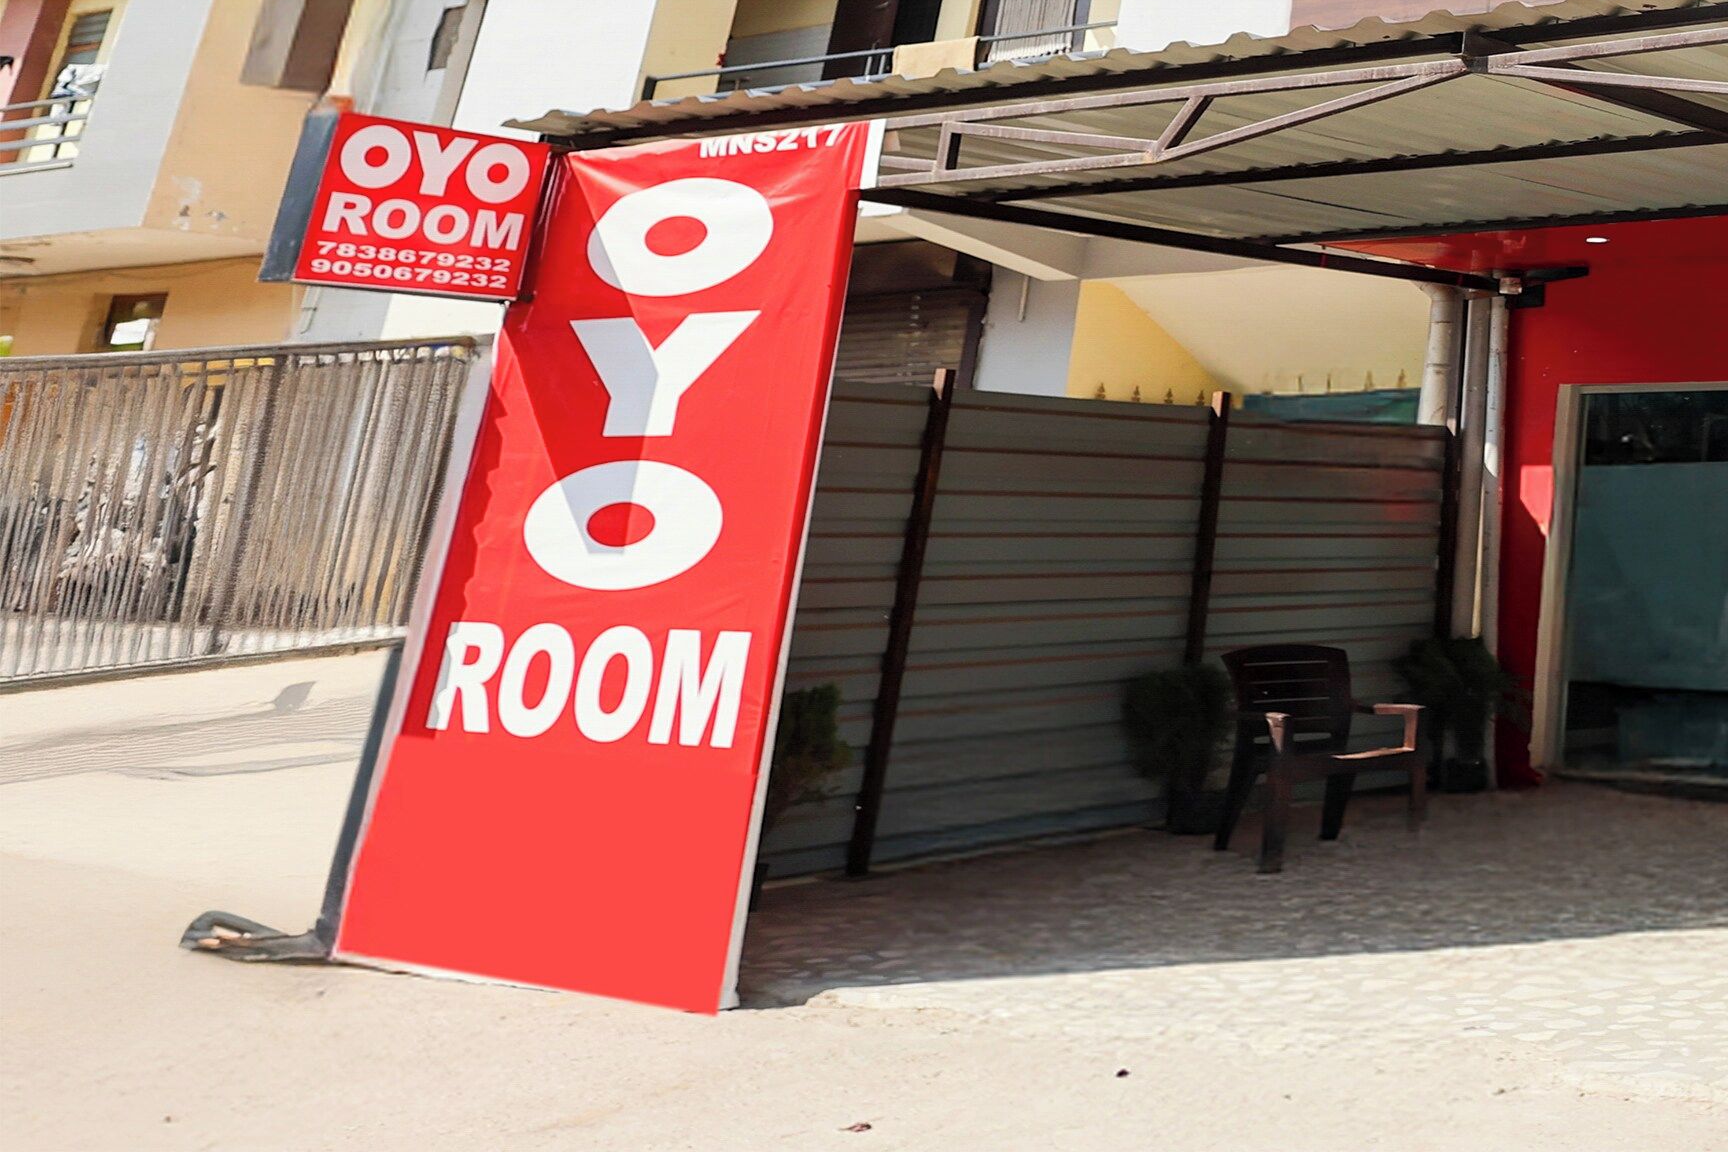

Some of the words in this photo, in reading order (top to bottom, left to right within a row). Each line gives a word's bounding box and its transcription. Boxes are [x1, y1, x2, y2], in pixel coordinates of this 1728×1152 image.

[340, 125, 530, 203] OYO
[700, 123, 845, 158] MNS217
[322, 191, 525, 250] ROOM
[311, 259, 508, 288] 9050679232
[316, 241, 511, 272] 7838679232
[524, 177, 774, 591] OYO
[426, 621, 752, 749] ROOM
